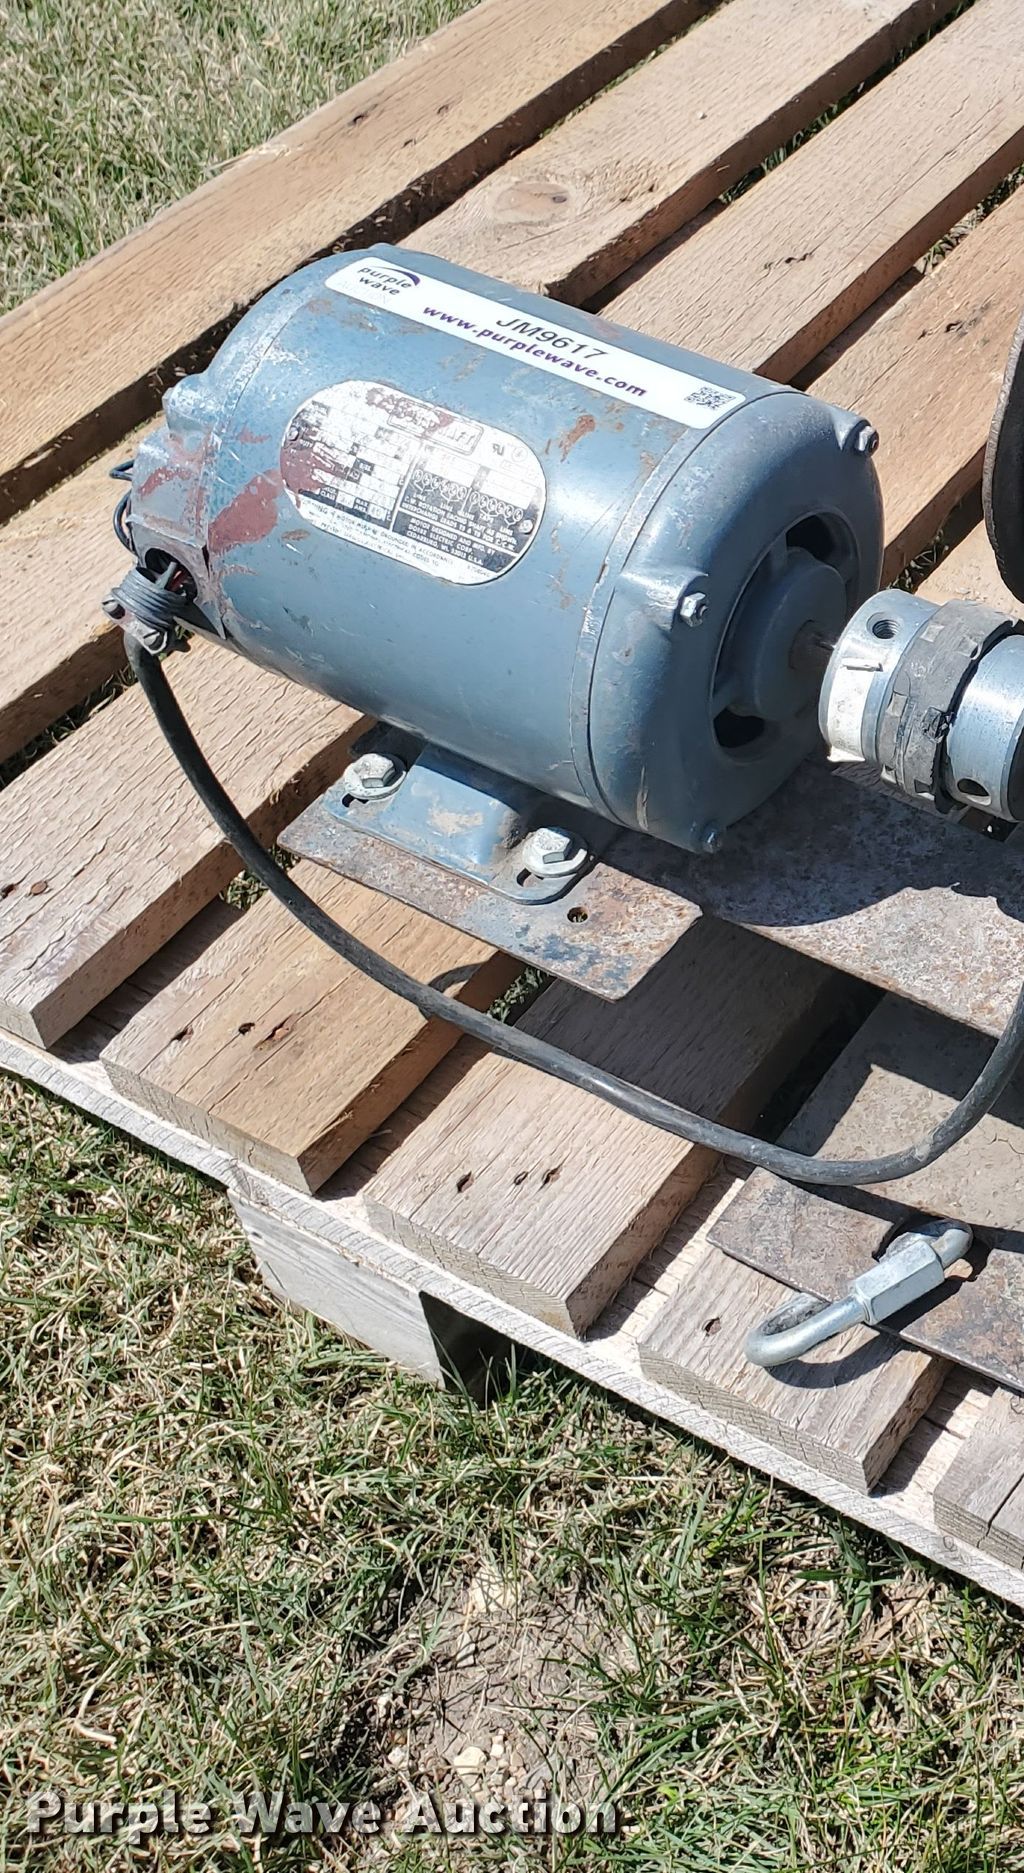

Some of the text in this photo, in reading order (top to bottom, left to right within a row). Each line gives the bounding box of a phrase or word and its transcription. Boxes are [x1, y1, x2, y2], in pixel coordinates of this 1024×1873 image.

[357, 267, 411, 288] purple
[360, 277, 400, 295] wave
[423, 307, 648, 397] www.purplewave.com
[496, 318, 608, 359] JM9617
